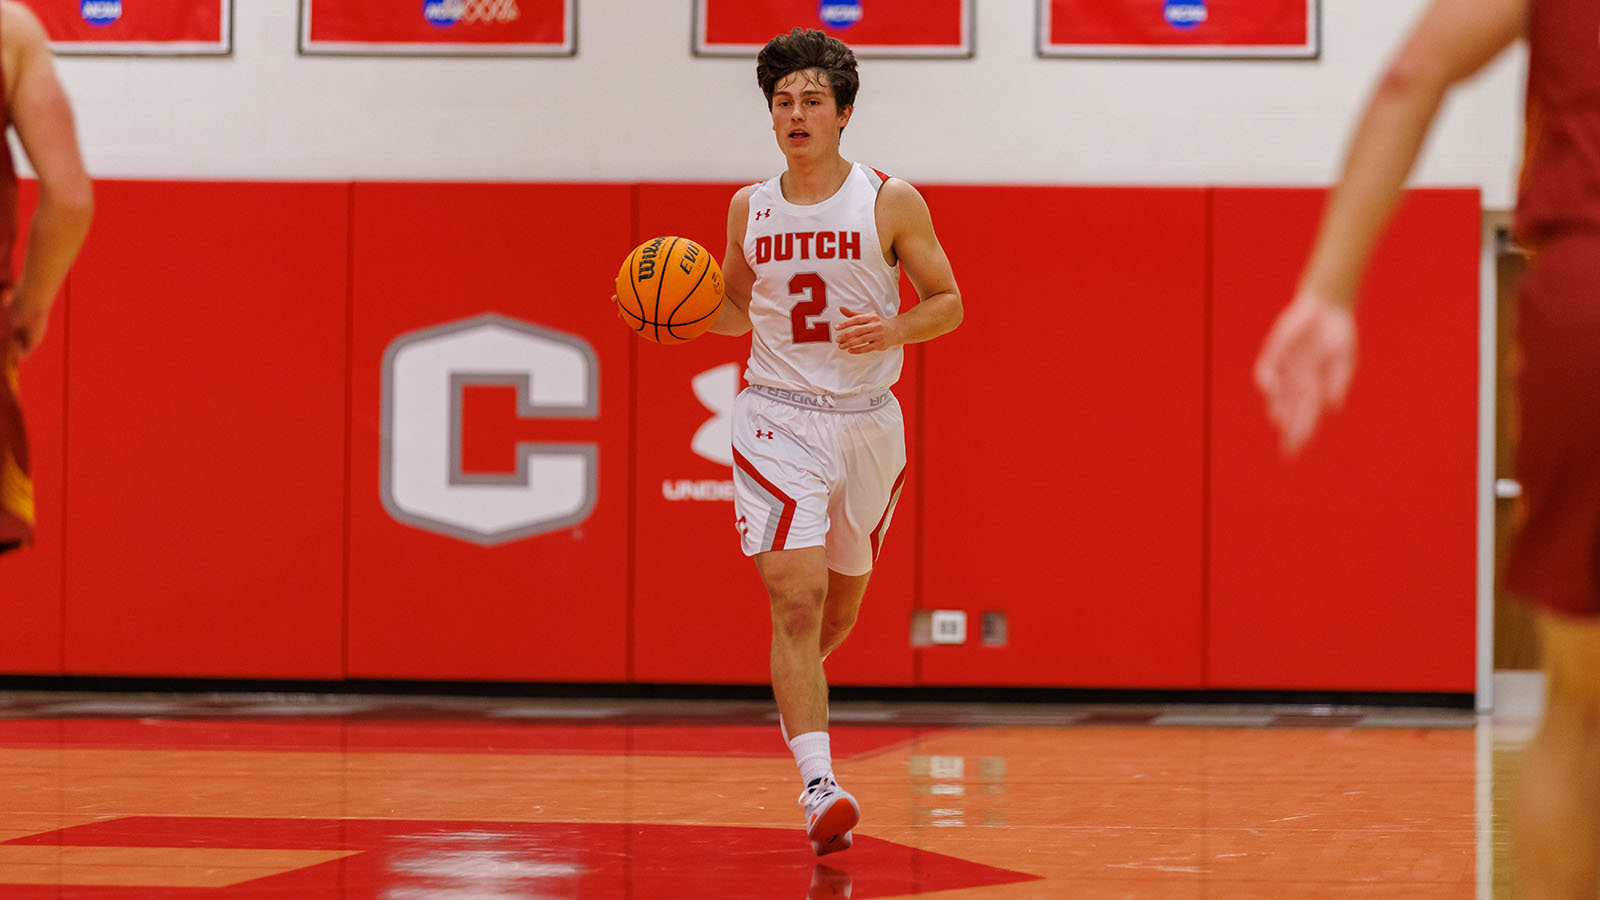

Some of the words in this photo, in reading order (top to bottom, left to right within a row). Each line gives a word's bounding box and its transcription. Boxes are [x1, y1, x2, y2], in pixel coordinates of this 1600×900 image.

[755, 231, 861, 265] DUTCH
[787, 271, 832, 345] 2
[379, 311, 599, 547] C
